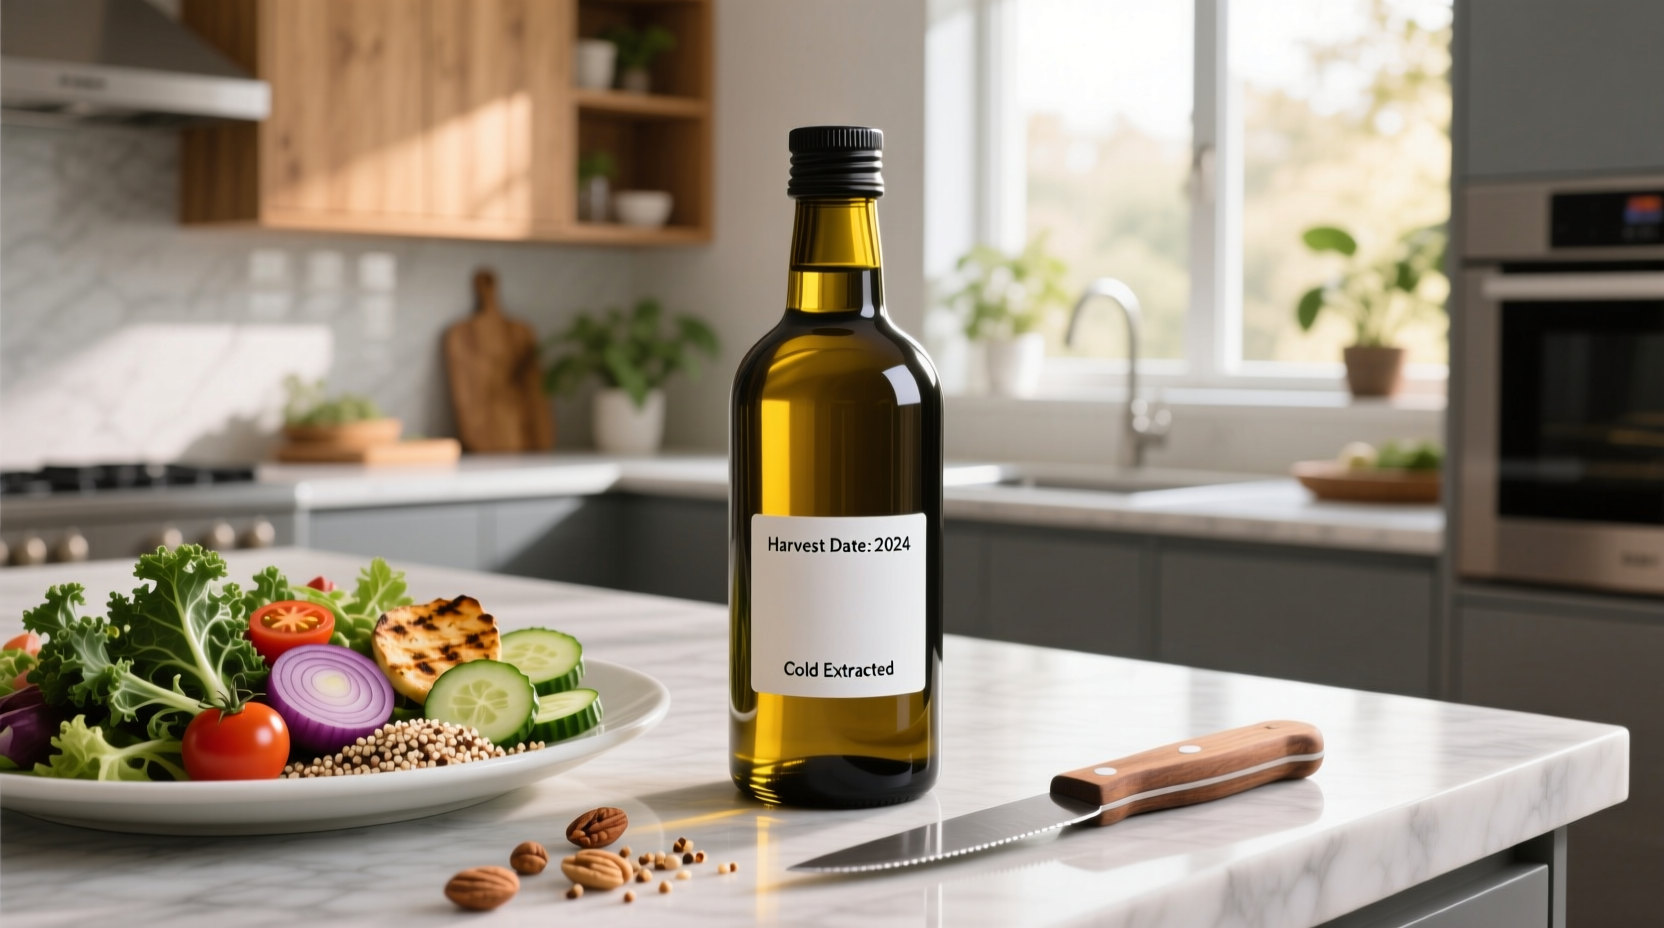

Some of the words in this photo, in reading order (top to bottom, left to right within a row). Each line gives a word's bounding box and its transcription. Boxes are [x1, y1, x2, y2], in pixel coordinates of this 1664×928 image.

[768, 535, 826, 553] Harvest
[829, 537, 872, 553] Date:
[874, 535, 911, 552] 2024
[783, 660, 819, 678] Cold
[823, 659, 895, 679] Extracted
